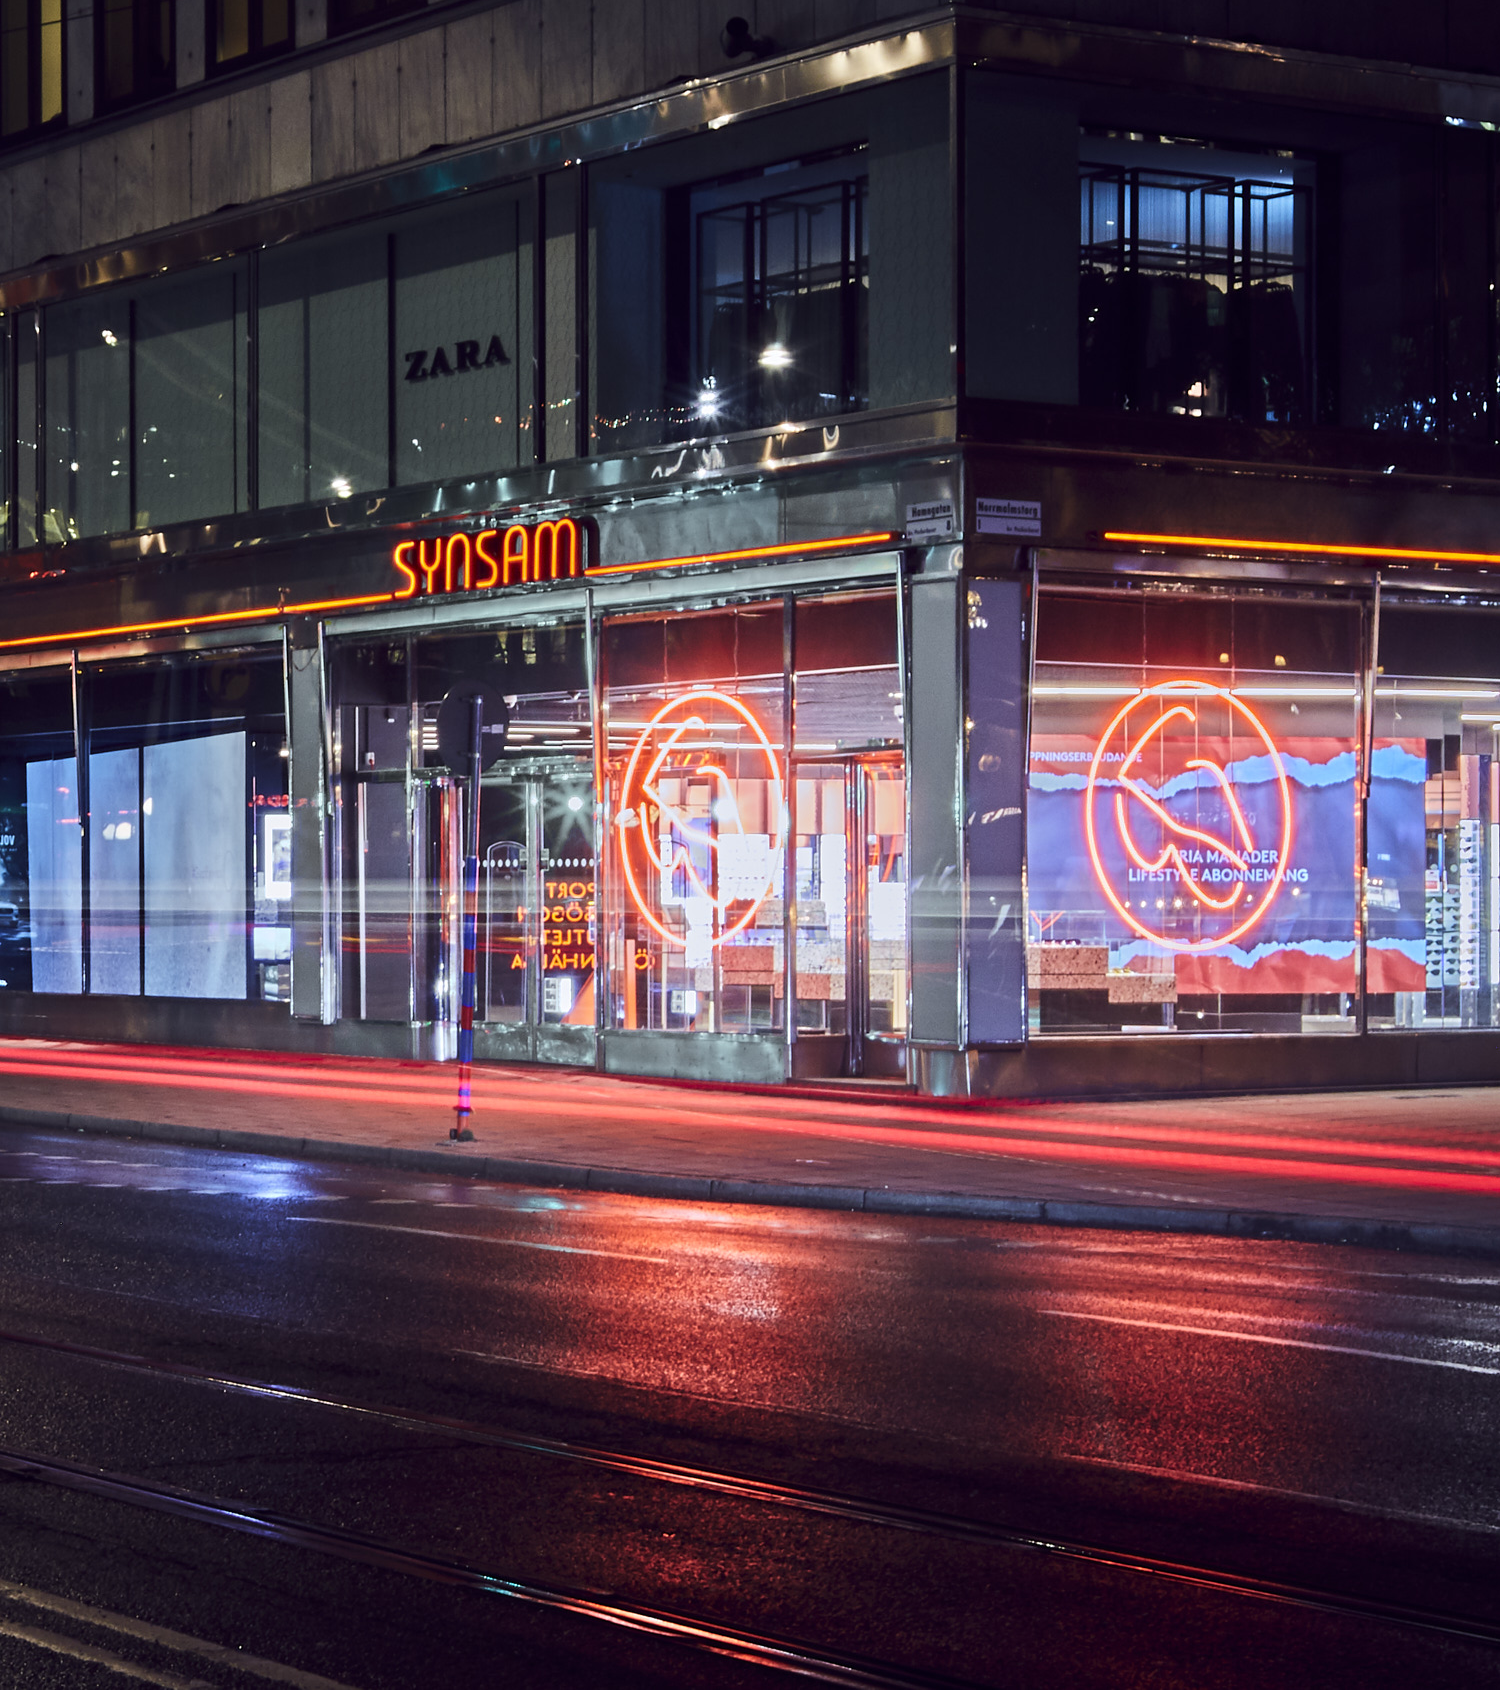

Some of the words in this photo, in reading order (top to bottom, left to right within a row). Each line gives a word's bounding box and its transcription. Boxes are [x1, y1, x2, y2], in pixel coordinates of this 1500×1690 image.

[404, 334, 511, 384] ZARA
[978, 501, 1038, 518] Norrmalmstorg
[393, 515, 578, 599] SYNSAM
[1128, 868, 1198, 882] LIFESTYE
